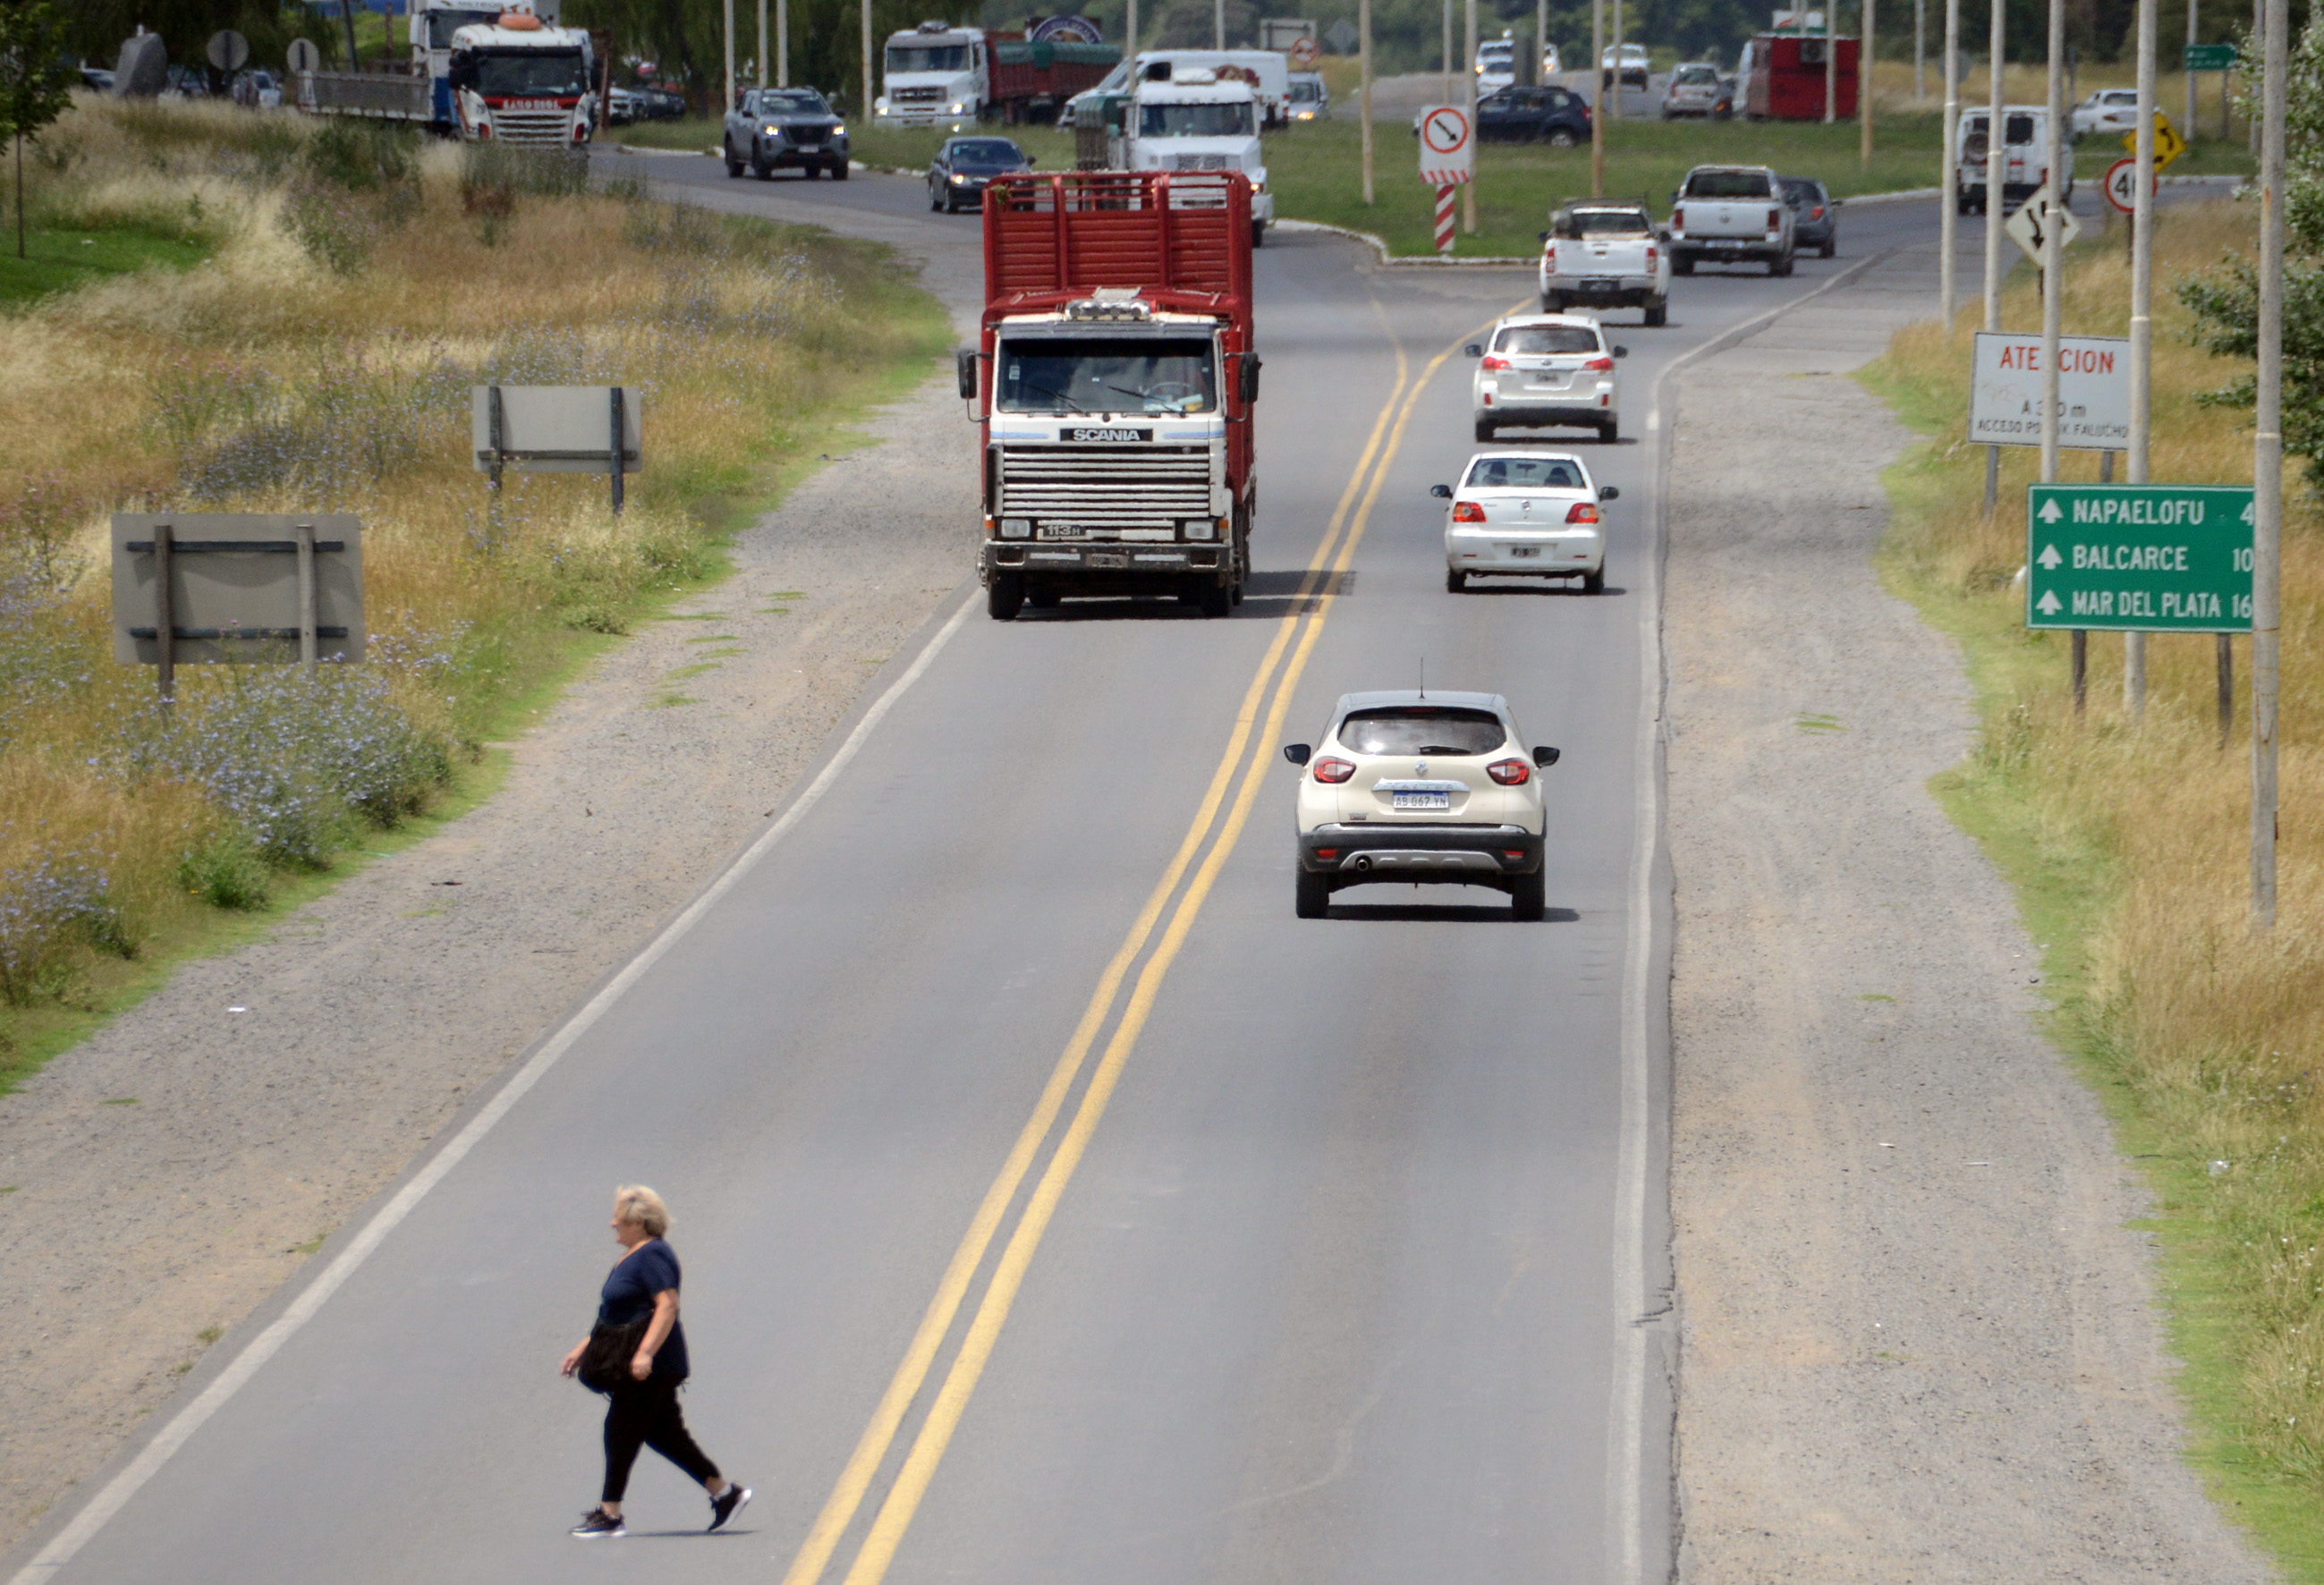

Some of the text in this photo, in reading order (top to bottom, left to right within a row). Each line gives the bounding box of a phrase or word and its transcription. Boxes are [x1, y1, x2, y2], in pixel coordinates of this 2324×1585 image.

[1999, 345, 2115, 374] ATECION
[2036, 400, 2067, 418] 30
[1073, 429, 1141, 442] SCANIA
[1977, 419, 2023, 433] ACCESO
[2025, 421, 2042, 435] PO
[2072, 498, 2206, 525] NAPAELOFU
[2072, 545, 2190, 572] BALCARCE
[2072, 590, 2114, 616] MAR
[2117, 591, 2157, 617] DEL
[2161, 592, 2222, 619] PLATA
[1411, 796, 1430, 807] 067
